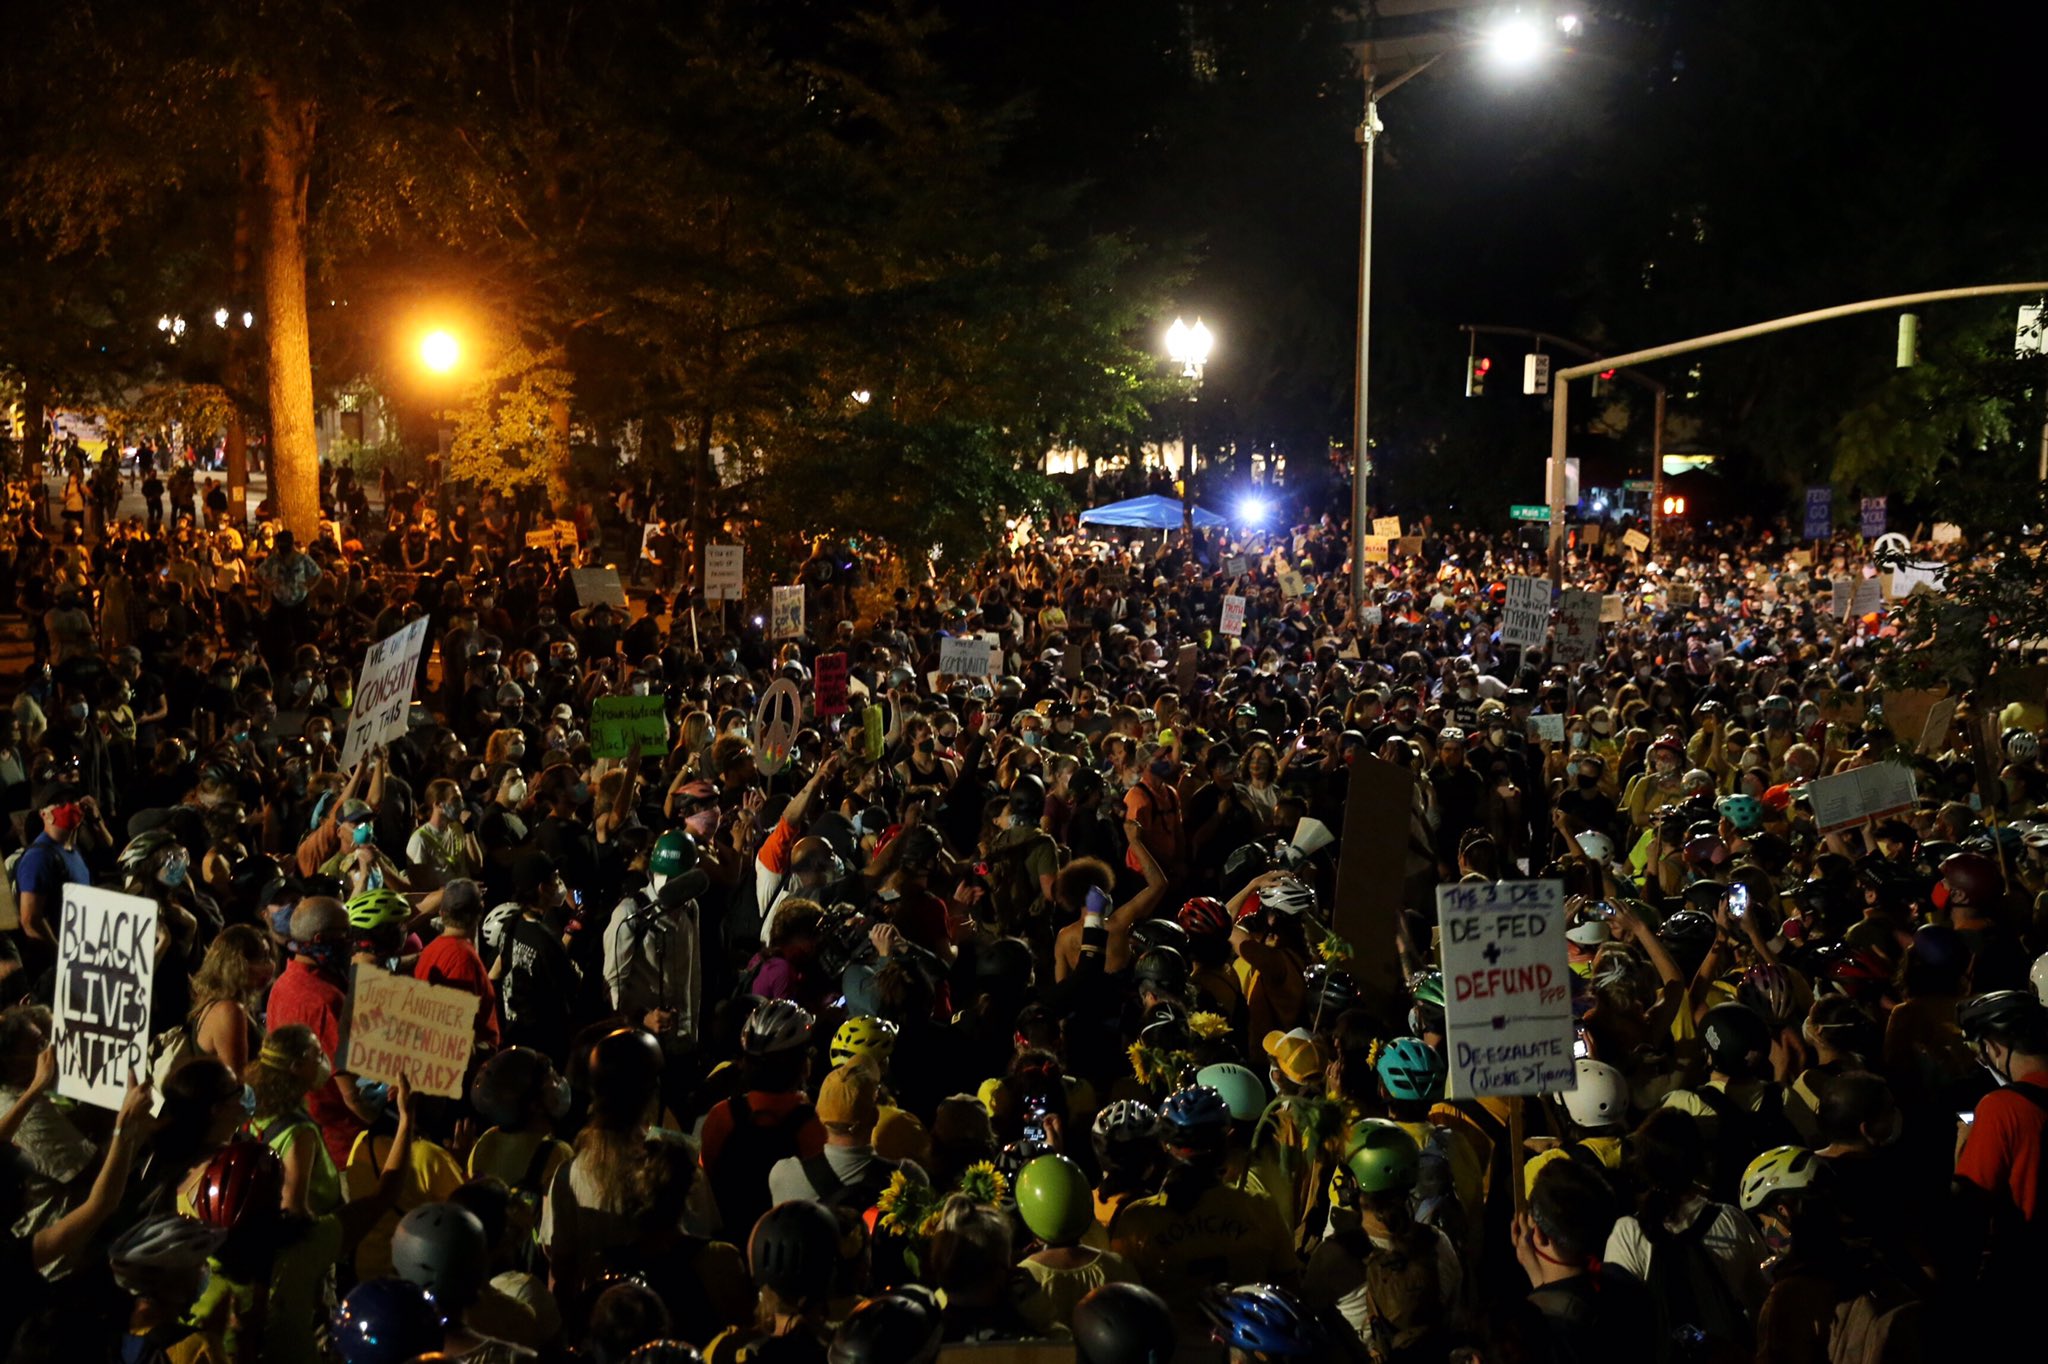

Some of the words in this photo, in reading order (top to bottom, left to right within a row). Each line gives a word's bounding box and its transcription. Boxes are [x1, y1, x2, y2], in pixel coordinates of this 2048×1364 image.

[1809, 504, 1829, 520] GO
[1861, 510, 1886, 524] YOU
[1508, 578, 1549, 602] THIS
[1509, 598, 1519, 607] IS
[1521, 600, 1550, 613] WHAT
[369, 641, 386, 667] WE
[940, 655, 989, 675] COMMUNITY
[355, 653, 420, 719] CONSENT
[354, 720, 373, 751] TO
[378, 698, 403, 732] THIS
[591, 727, 627, 752] Black
[1444, 886, 1478, 908] THE
[1482, 884, 1497, 903] 3
[62, 900, 152, 975] BLACK
[63, 967, 147, 1033] LIVES
[1455, 963, 1552, 1001] DEFUND
[359, 977, 399, 1008] JUST
[401, 985, 465, 1029] ANOTHER
[54, 1026, 142, 1088] MATTER
[386, 1016, 468, 1062] DEFENDING
[350, 1041, 461, 1091] DEMOCRACY
